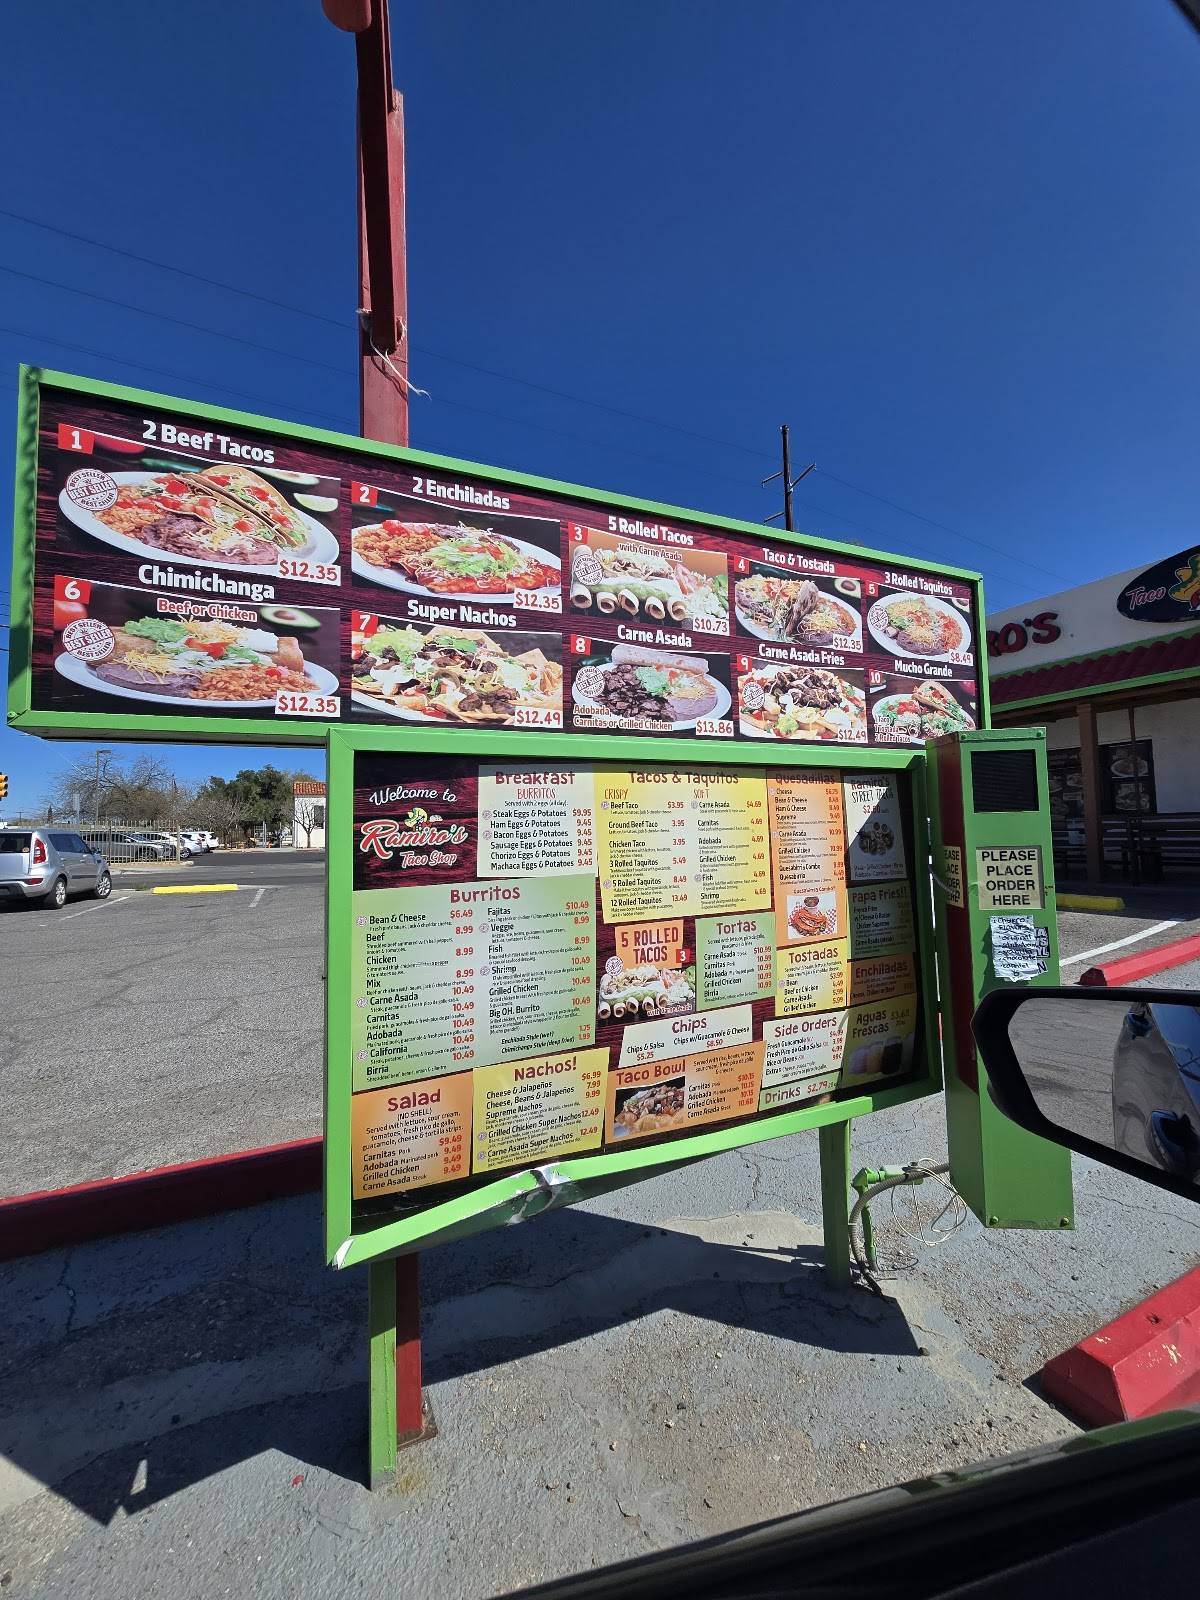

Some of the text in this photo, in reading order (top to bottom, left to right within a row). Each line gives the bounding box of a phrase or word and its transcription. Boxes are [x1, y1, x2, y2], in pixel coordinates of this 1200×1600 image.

[71, 431, 82, 449] 1
[143, 420, 274, 463] 2 Beef Tacos
[70, 472, 105, 487] BEST SELLER
[70, 480, 116, 499] BEST SELLER
[360, 486, 370, 502] 2
[412, 477, 510, 509] 2 Enchiladas
[575, 527, 582, 540] 3
[609, 516, 693, 545] 5 Rolled Tacos
[639, 546, 660, 556] Carne
[661, 551, 682, 561] Asada
[763, 548, 835, 573] Taco & Tostada
[279, 560, 337, 581] $12.35
[739, 560, 745, 571] 4
[65, 581, 80, 599] 6
[139, 565, 274, 600] Chimichanga
[869, 584, 875, 594] 5
[885, 572, 952, 594] 3 Rolled Taquitos
[516, 592, 559, 609] $12.35
[1127, 586, 1166, 610] Taco
[158, 599, 256, 621] Beef or Chicken
[408, 600, 516, 627] Super Nachos
[360, 615, 370, 631] 7
[695, 619, 727, 632] $10.73
[64, 628, 113, 651] BEST SELLER
[618, 625, 692, 647] Carne Asada
[834, 638, 861, 650] $12.35
[576, 638, 585, 652] 8
[759, 644, 844, 665] Carne Asada Fries
[951, 652, 970, 663] $8.49
[741, 658, 748, 670] 9
[895, 660, 952, 677] Mucho Grande
[871, 672, 880, 683] 10
[278, 696, 337, 713] $12.35
[574, 705, 611, 716] Adobada,
[517, 712, 560, 725] $12.49
[575, 717, 607, 727] Carnitas
[619, 720, 643, 729] Grilled
[645, 721, 672, 730] Chicken
[697, 721, 732, 733] $13.86
[839, 729, 866, 740] $12.49
[495, 772, 575, 784] Breakfast
[629, 771, 738, 787] Tacos & Taquitos
[776, 773, 835, 784] Quesadillas
[369, 786, 457, 805] Welcome to
[518, 788, 555, 799] BURRITOS
[605, 788, 628, 799] CRISPY
[493, 810, 512, 818] Steak
[514, 810, 529, 819] Eggs
[573, 808, 591, 816] $9.95
[360, 820, 468, 859] Ramiro's
[516, 831, 531, 839] Eggs
[400, 851, 457, 868] Taco Shop
[982, 850, 1036, 861] PLEASE
[987, 865, 1032, 876] PLACE
[637, 878, 661, 886] Taquitos
[986, 880, 1035, 890] ORDER
[450, 886, 520, 903] Burritos
[852, 891, 876, 902] Papa
[993, 895, 1030, 905] HERE
[370, 916, 389, 924] Bean
[399, 914, 425, 922] Cheese
[450, 909, 473, 919] $6.49
[491, 923, 514, 932] Veggie
[574, 916, 589, 924] 8.99
[366, 933, 385, 941] Beef
[456, 926, 473, 934] 8.99
[716, 919, 756, 935] Tortas
[622, 927, 679, 947] 5 ROLLED
[367, 955, 396, 965] Chicken
[456, 947, 473, 956] 8.99
[633, 947, 667, 964] TACOS
[680, 951, 686, 961] 3
[789, 948, 838, 964] Tostadas
[370, 985, 474, 1005] Carne Asada 10.49
[857, 1010, 887, 1025] Aguas
[366, 1018, 474, 1041] Adobada 10.49
[672, 1018, 707, 1034] Chips
[775, 1017, 837, 1037] Side Orders
[852, 1023, 889, 1039] Frescas
[370, 1034, 474, 1057] California 10.49
[627, 1041, 665, 1054] Chips & Salsa
[637, 1052, 654, 1061] $5.25
[515, 1056, 576, 1081] Nachos!
[616, 1070, 649, 1085] Taco
[654, 1060, 685, 1077] Bowl
[487, 1089, 511, 1099] Cheese
[519, 1082, 552, 1093] Jalapeños
[582, 1071, 601, 1080] $6.99
[765, 1081, 827, 1104] Drinks $2.79
[388, 1089, 441, 1112] Salad
[398, 1108, 432, 1121] (NO SHELL)
[364, 1135, 462, 1162] Carnitas $9.49
